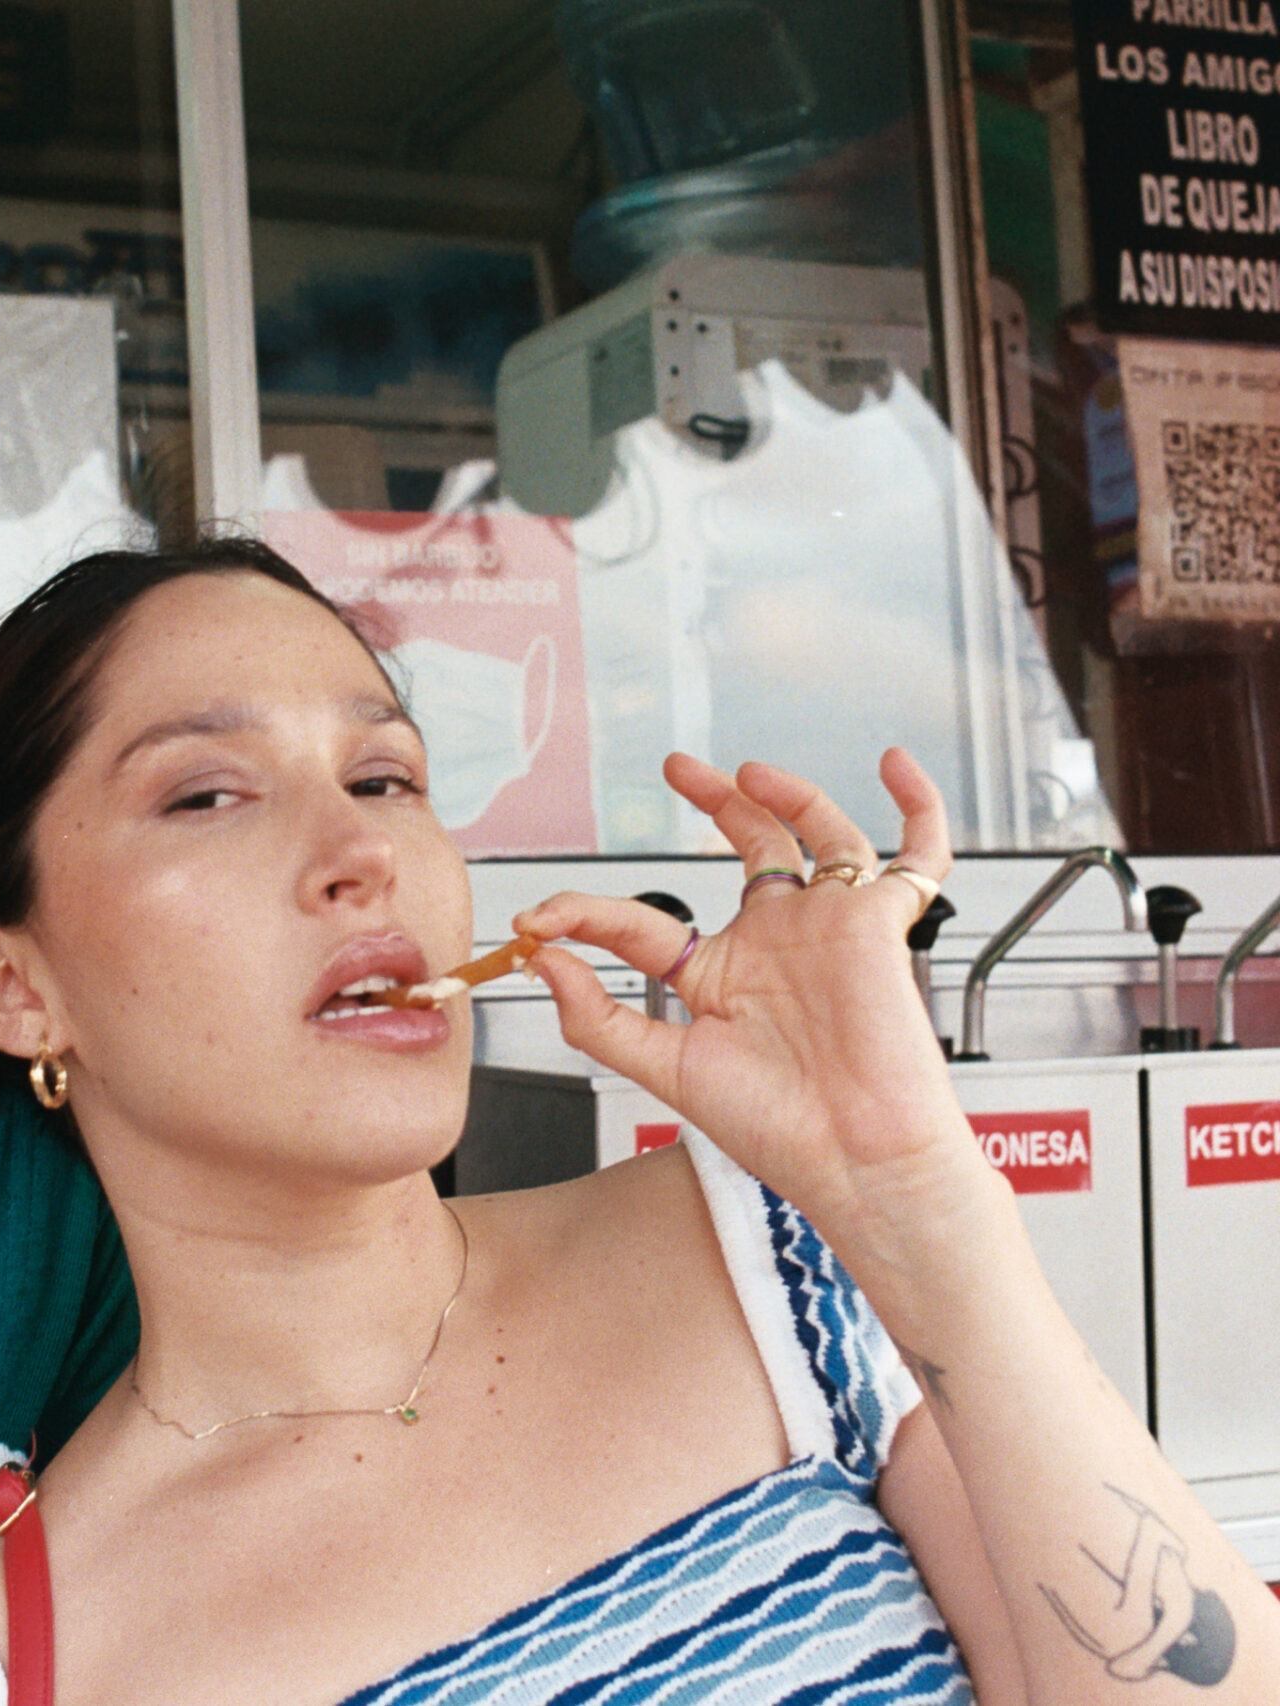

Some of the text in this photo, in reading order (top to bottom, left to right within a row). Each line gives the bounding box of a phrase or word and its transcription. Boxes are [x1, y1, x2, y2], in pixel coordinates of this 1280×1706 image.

[1133, 0, 1277, 36] PARRILLA
[1096, 43, 1169, 85] LOS
[1167, 108, 1259, 166] LIBRO
[1140, 173, 1184, 229] DE
[1120, 249, 1280, 312] A SU DISPOSI
